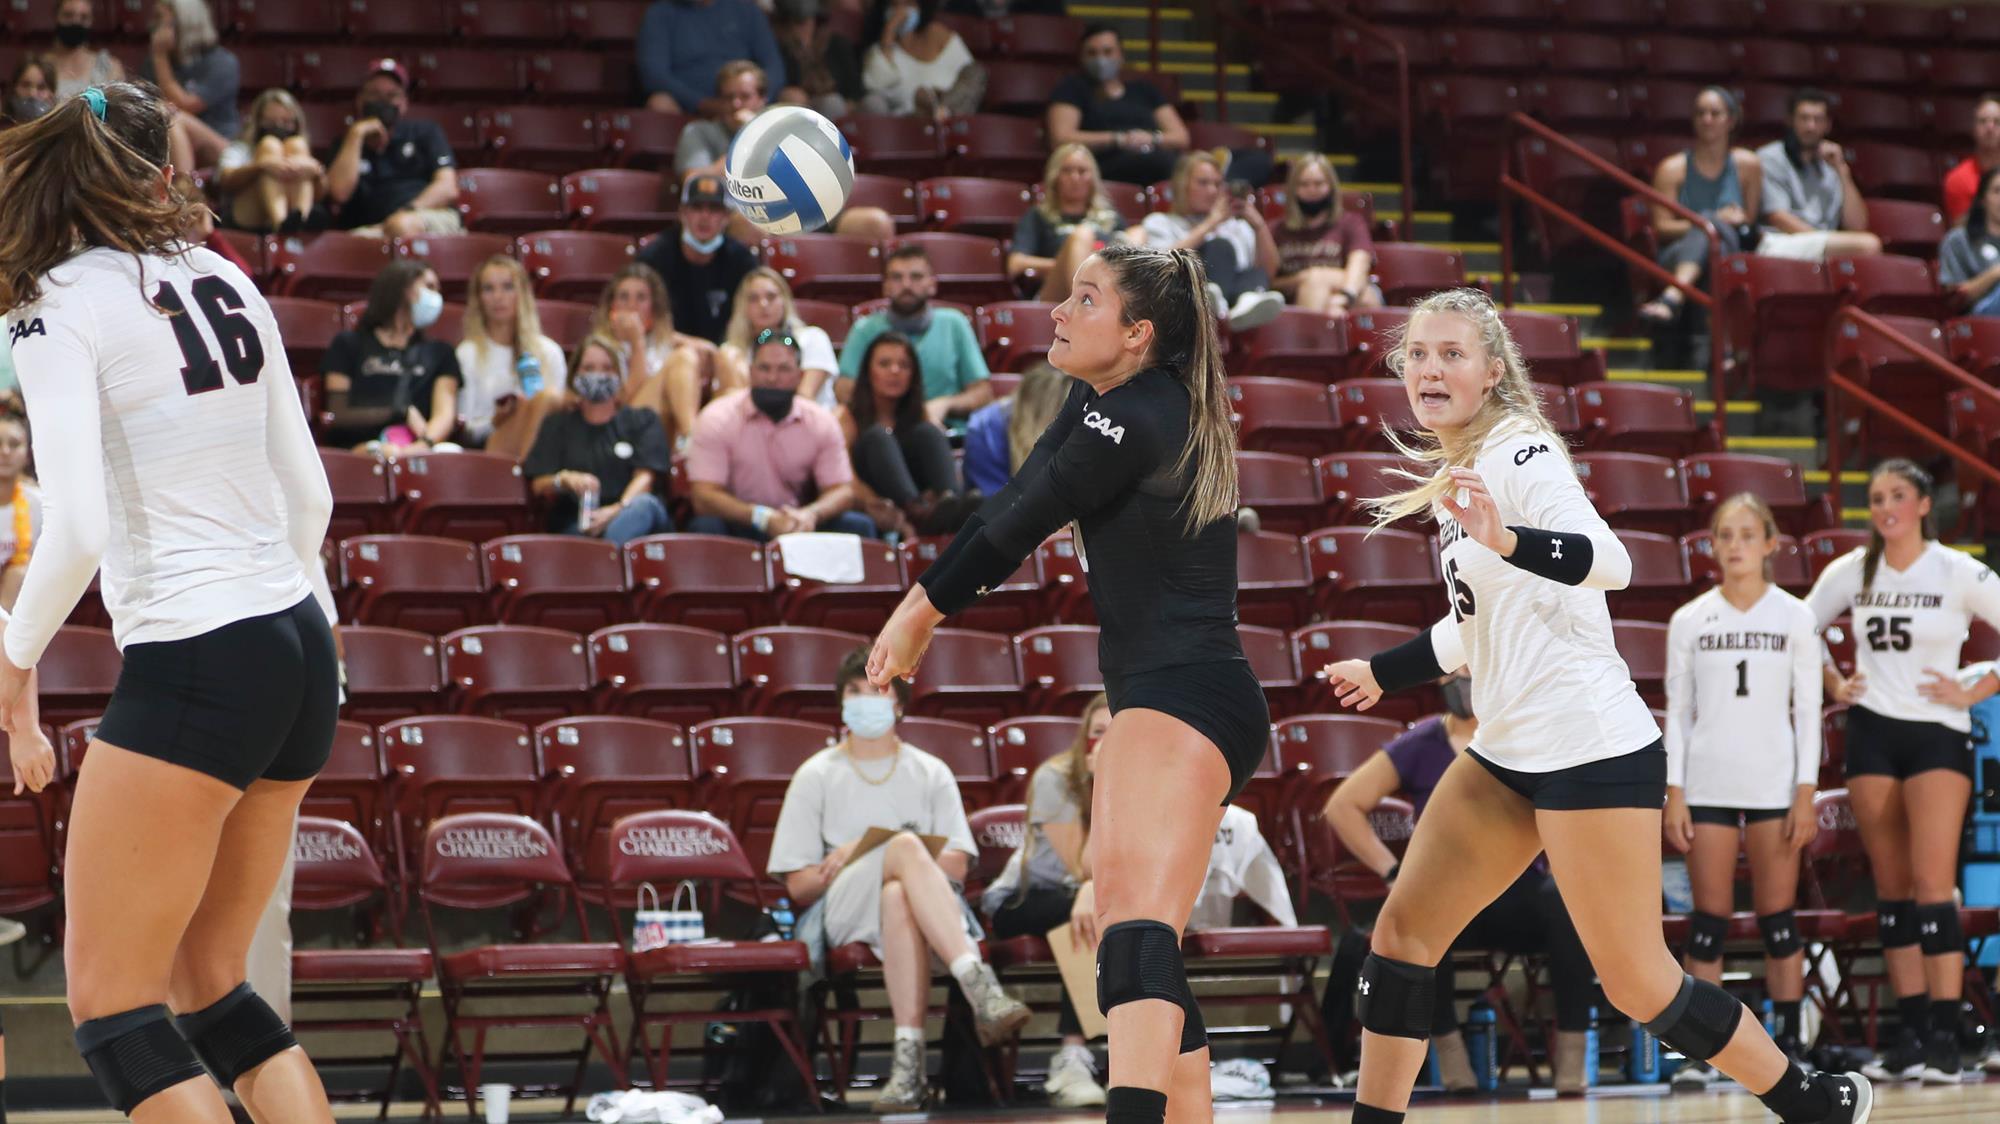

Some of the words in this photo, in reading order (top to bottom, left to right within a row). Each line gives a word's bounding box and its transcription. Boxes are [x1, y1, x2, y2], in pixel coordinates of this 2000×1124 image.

[727, 179, 763, 199] olten
[152, 275, 264, 396] 16
[1084, 411, 1125, 444] CAA
[1513, 444, 1550, 466] CAA
[1699, 632, 1788, 651] CHARLESTON
[1866, 616, 1912, 652] 25
[1736, 660, 1749, 696] 1
[446, 828, 517, 842] COLLEGE
[627, 827, 699, 841] COLLEGE
[295, 843, 361, 861] LESTON
[436, 839, 548, 858] CHARLESTON
[619, 837, 730, 857] CHARLESTON
